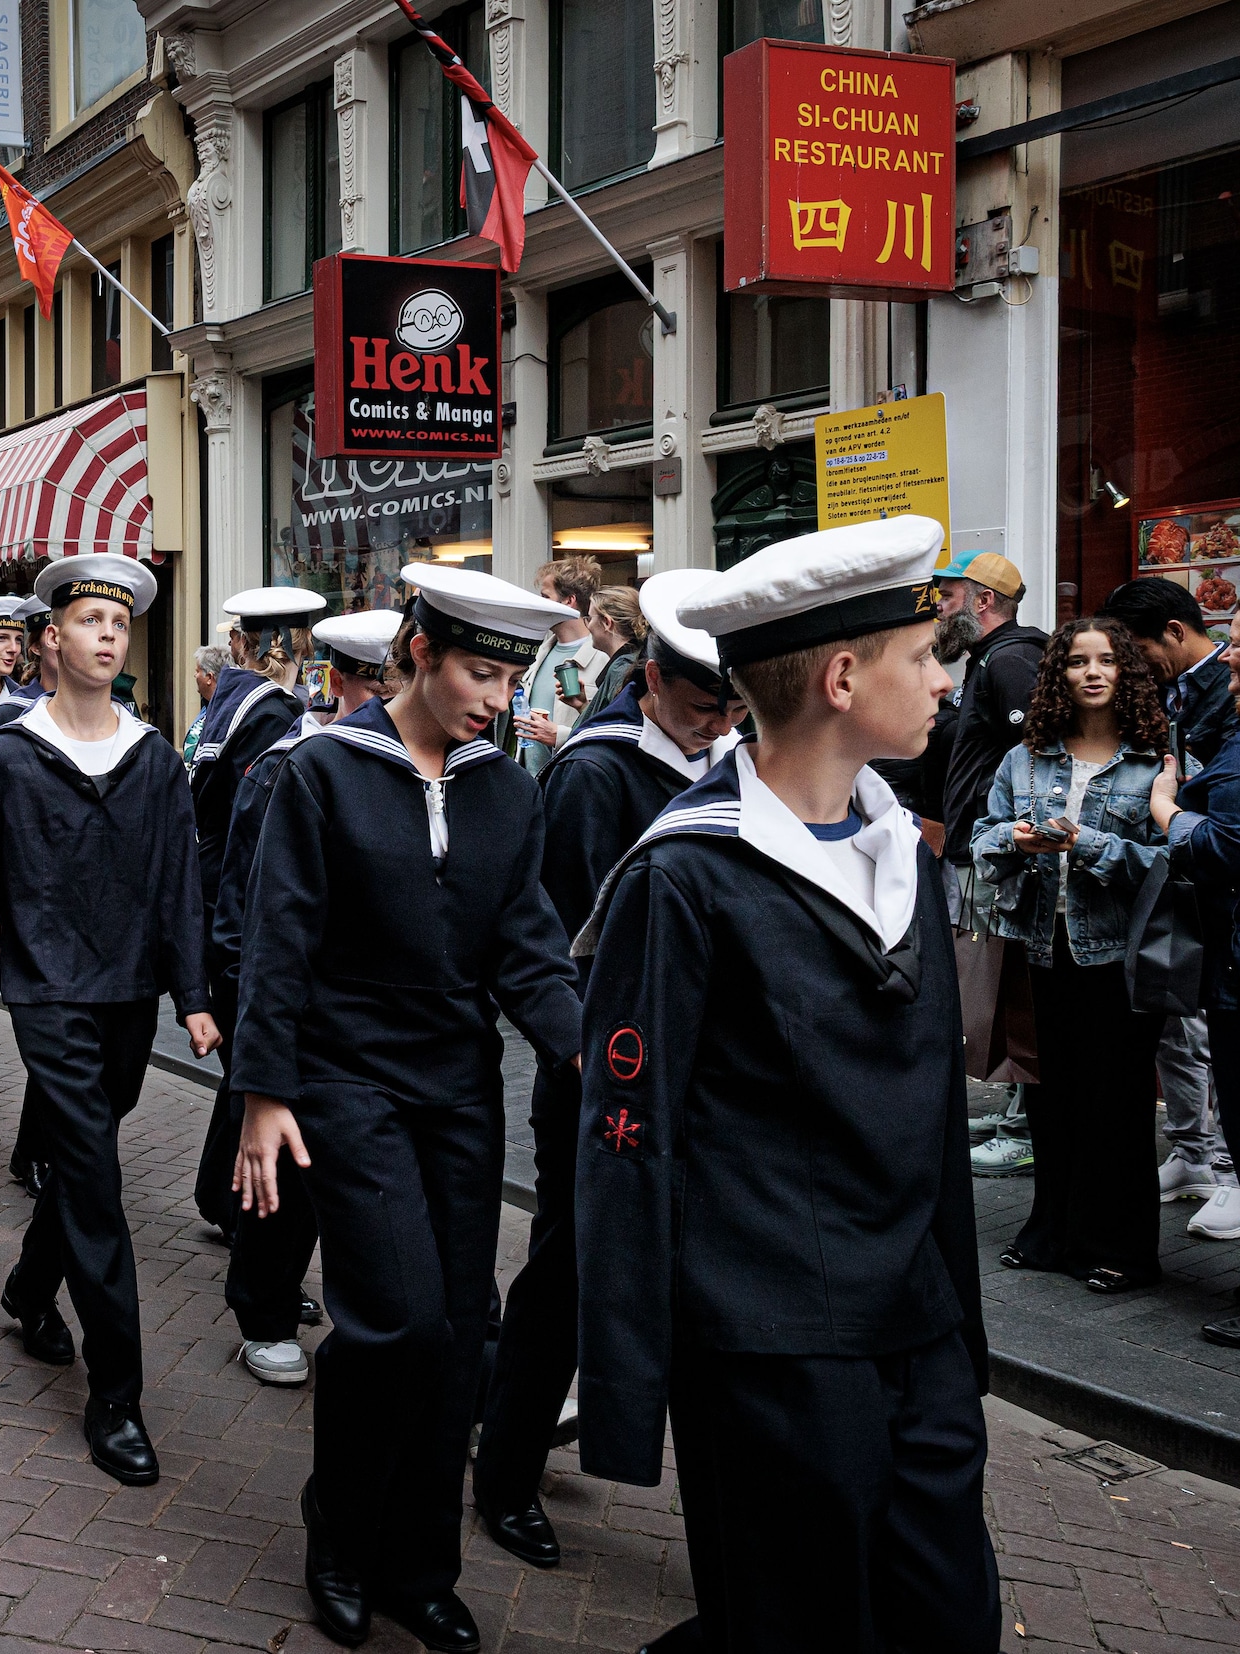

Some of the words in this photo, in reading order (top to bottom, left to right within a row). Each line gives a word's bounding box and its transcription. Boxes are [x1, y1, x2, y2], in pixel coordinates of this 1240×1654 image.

[820, 68, 898, 98] CHINA
[797, 103, 919, 136] SI-CHUAN
[774, 138, 944, 174] RESTAURANT
[787, 192, 933, 272] 四川
[349, 336, 491, 395] Henk
[349, 398, 409, 419] Comics
[416, 401, 430, 420] &
[435, 402, 493, 427] Manga
[351, 428, 494, 442] WWW.COMICS.NL
[834, 434, 852, 446] grond
[864, 440, 885, 448] worden
[826, 465, 866, 476] (brom)fietsen
[859, 483, 893, 494] fietsnietjes
[903, 476, 945, 487] fietsenrekken
[827, 501, 838, 510] zijn
[828, 511, 847, 519] Sloten
[850, 508, 871, 517] worden
[475, 632, 512, 650] CORPS
[513, 642, 531, 655] DES
[1002, 1146, 1033, 1162] HOKA
